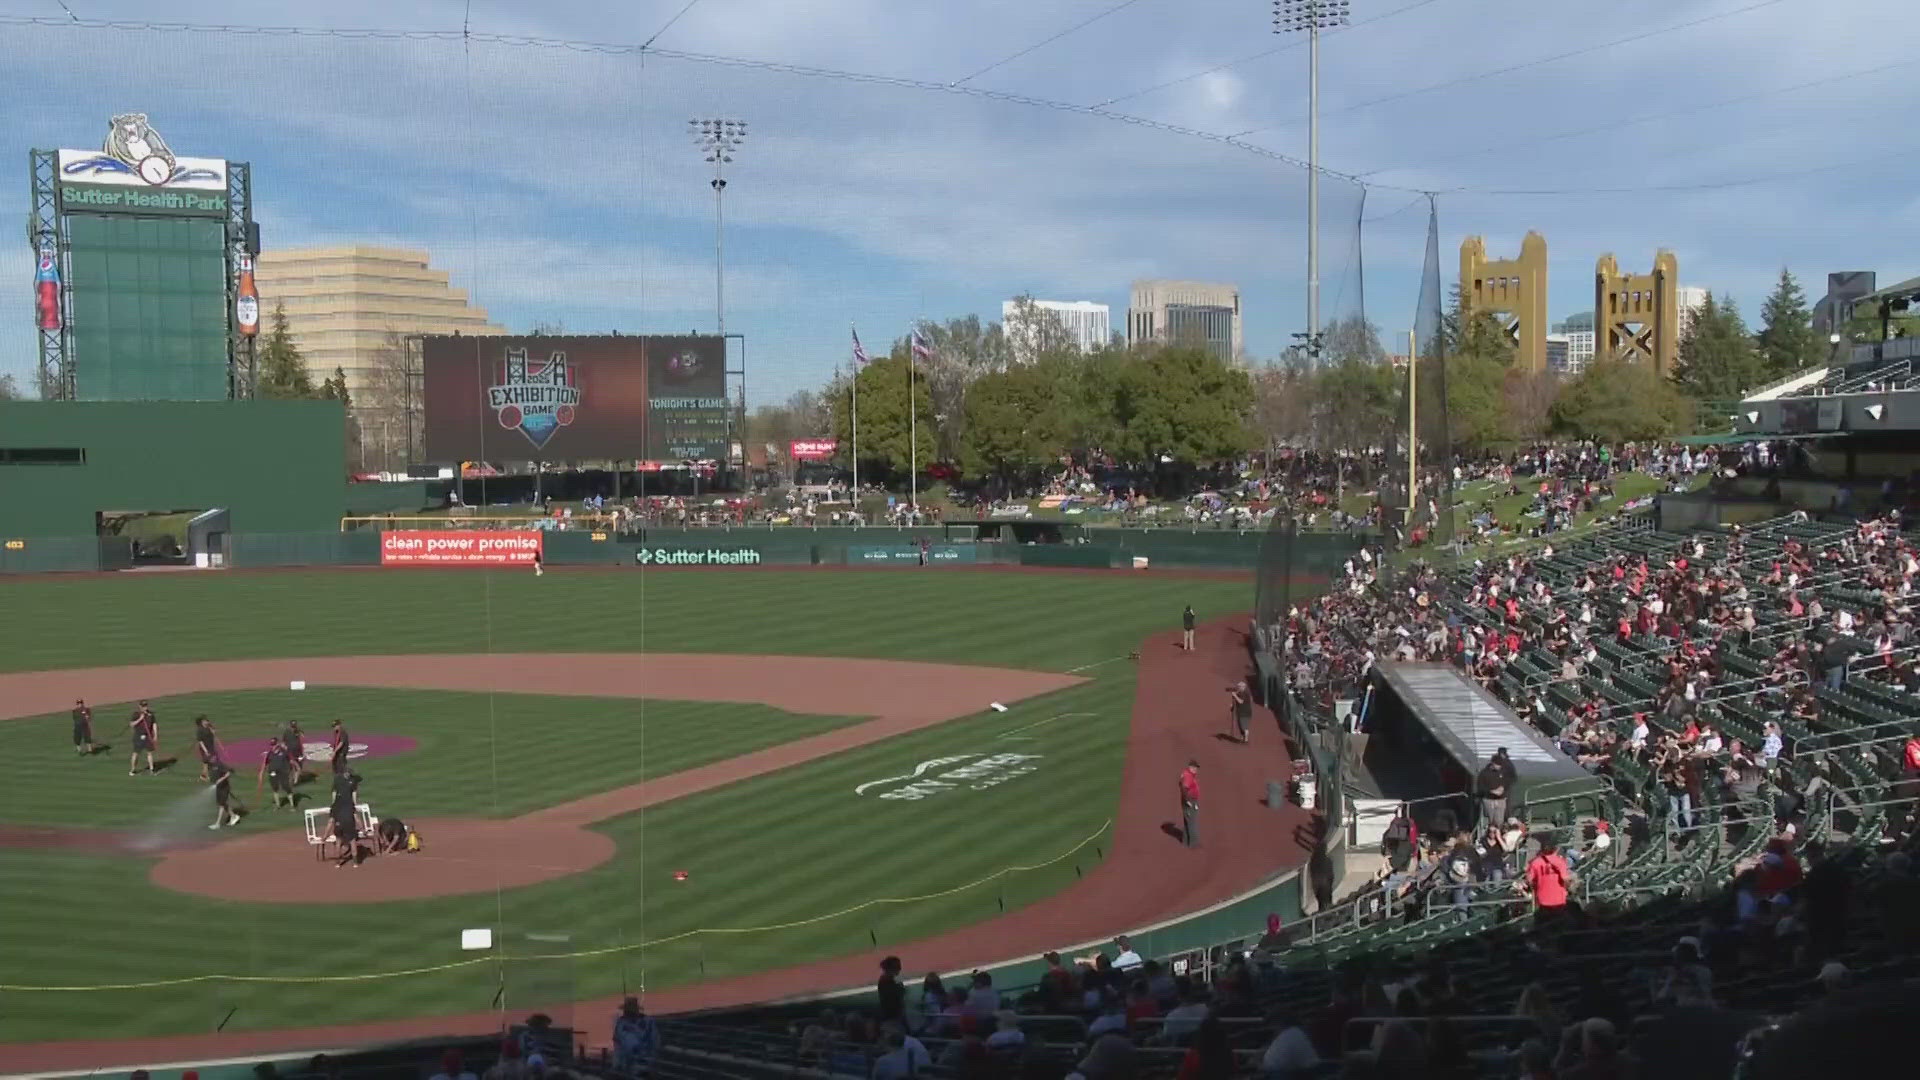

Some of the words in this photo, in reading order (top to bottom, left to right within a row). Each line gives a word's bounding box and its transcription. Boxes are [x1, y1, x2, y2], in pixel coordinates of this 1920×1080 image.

[62, 187, 123, 205] Sutter
[124, 190, 184, 209] Health
[185, 193, 227, 211] Park
[490, 387, 579, 406] EXHIBITION
[523, 405, 554, 415] GAME
[385, 536, 423, 549] clean
[428, 538, 474, 551] power
[479, 536, 538, 551] promise
[655, 549, 705, 565] Sutter
[707, 549, 760, 565] Health
